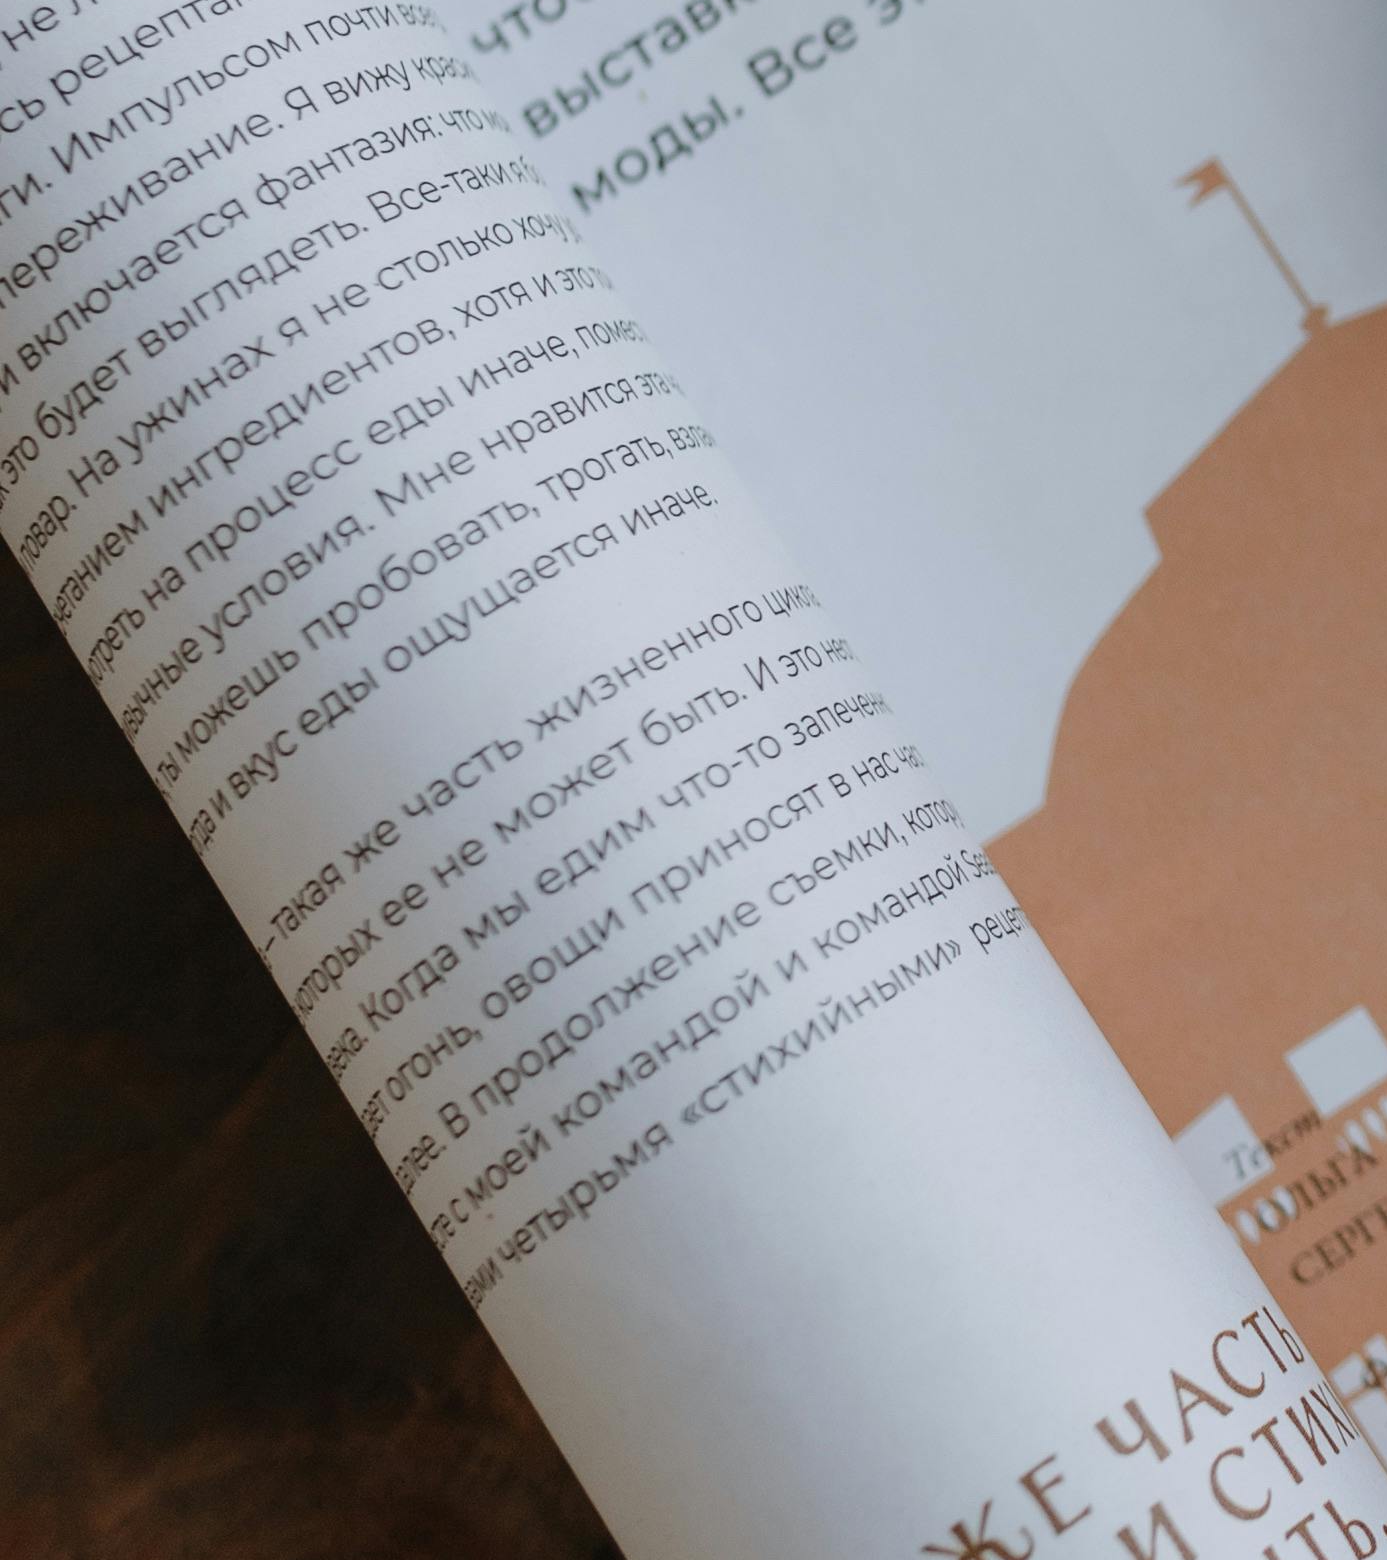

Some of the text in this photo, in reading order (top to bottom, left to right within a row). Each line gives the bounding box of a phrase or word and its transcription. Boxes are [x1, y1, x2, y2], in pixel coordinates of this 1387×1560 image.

[1, 5, 60, 53] не
[51, 4, 399, 174] Импульсом почти
[283, 85, 319, 121] Я
[323, 61, 410, 106] вижу
[572, 99, 745, 218] моды.
[748, 9, 859, 101] Все
[17, 198, 249, 371] включается
[256, 114, 443, 210] фантазия:
[439, 108, 484, 132] что
[36, 349, 132, 439] будет
[137, 217, 368, 358] выглядеть.
[366, 161, 512, 224] Все-таки
[67, 448, 121, 497] На
[118, 335, 276, 465] ужинах
[277, 316, 308, 346] я
[313, 283, 370, 325] не
[377, 223, 513, 291] столько
[53, 510, 148, 636] четанием
[148, 318, 456, 517] ингредиентов,
[453, 281, 533, 329] хотя
[531, 273, 557, 297] и
[555, 267, 594, 292] это
[141, 565, 186, 611] на
[185, 438, 363, 573] процесс
[367, 385, 456, 441] еды
[458, 333, 580, 398] иначе,
[199, 514, 375, 655] условия.
[374, 450, 475, 517] Мне
[481, 375, 638, 460] нравится
[174, 646, 301, 764] можешь
[301, 495, 541, 650] пробовать,
[535, 435, 674, 502] трогать,
[209, 483, 719, 820] и вкус еды ощущается иначе.
[270, 863, 346, 944] такая
[343, 818, 401, 874] же
[402, 729, 523, 821] часть
[527, 599, 764, 741] жизненного
[358, 942, 459, 1031] Когда
[463, 890, 532, 950] мы
[538, 804, 656, 896] едим
[658, 734, 782, 809] что-то
[381, 881, 430, 928] ее
[430, 838, 489, 890] не
[493, 738, 635, 845] может
[641, 688, 748, 748] быть.
[743, 656, 778, 691] И
[778, 645, 822, 677] это
[385, 750, 899, 1102] огонь, овощи приносят в нас
[438, 1101, 471, 1141] В
[472, 900, 761, 1117] продолжение
[768, 821, 909, 906] съемки,
[902, 799, 966, 834] котор
[450, 854, 970, 1223] с моей командой и командой
[497, 1120, 675, 1264] четырьмя
[680, 938, 962, 1126] «стихийными»
[1095, 1305, 1306, 1462] ЧАСТЬ
[1209, 1382, 1361, 1522] СТИХ
